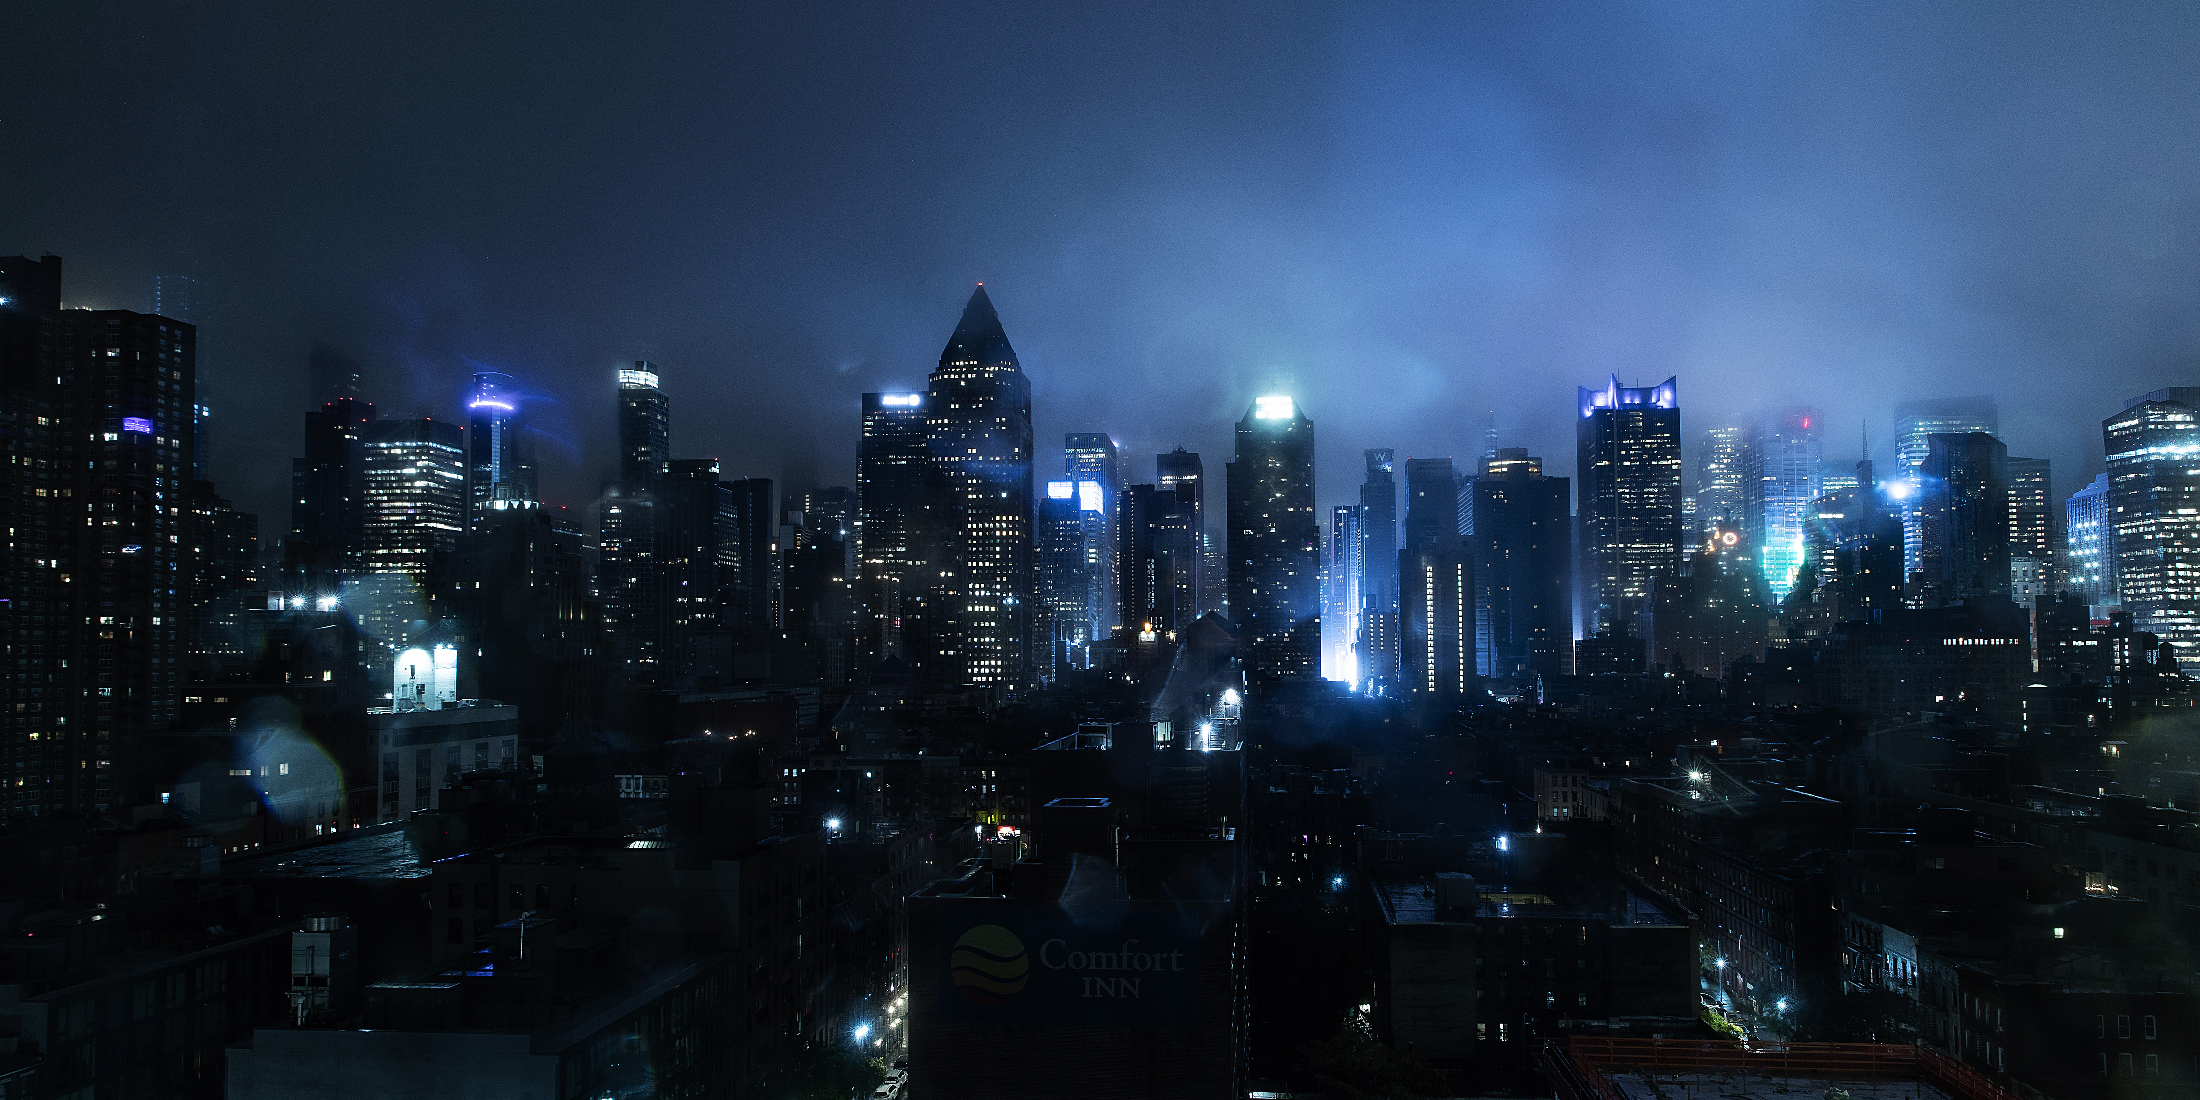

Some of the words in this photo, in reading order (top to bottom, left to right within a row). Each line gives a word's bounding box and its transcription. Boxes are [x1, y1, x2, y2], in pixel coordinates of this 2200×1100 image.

[1373, 452, 1387, 462] W
[1039, 938, 1185, 972] Comfort
[1081, 976, 1142, 999] INN
